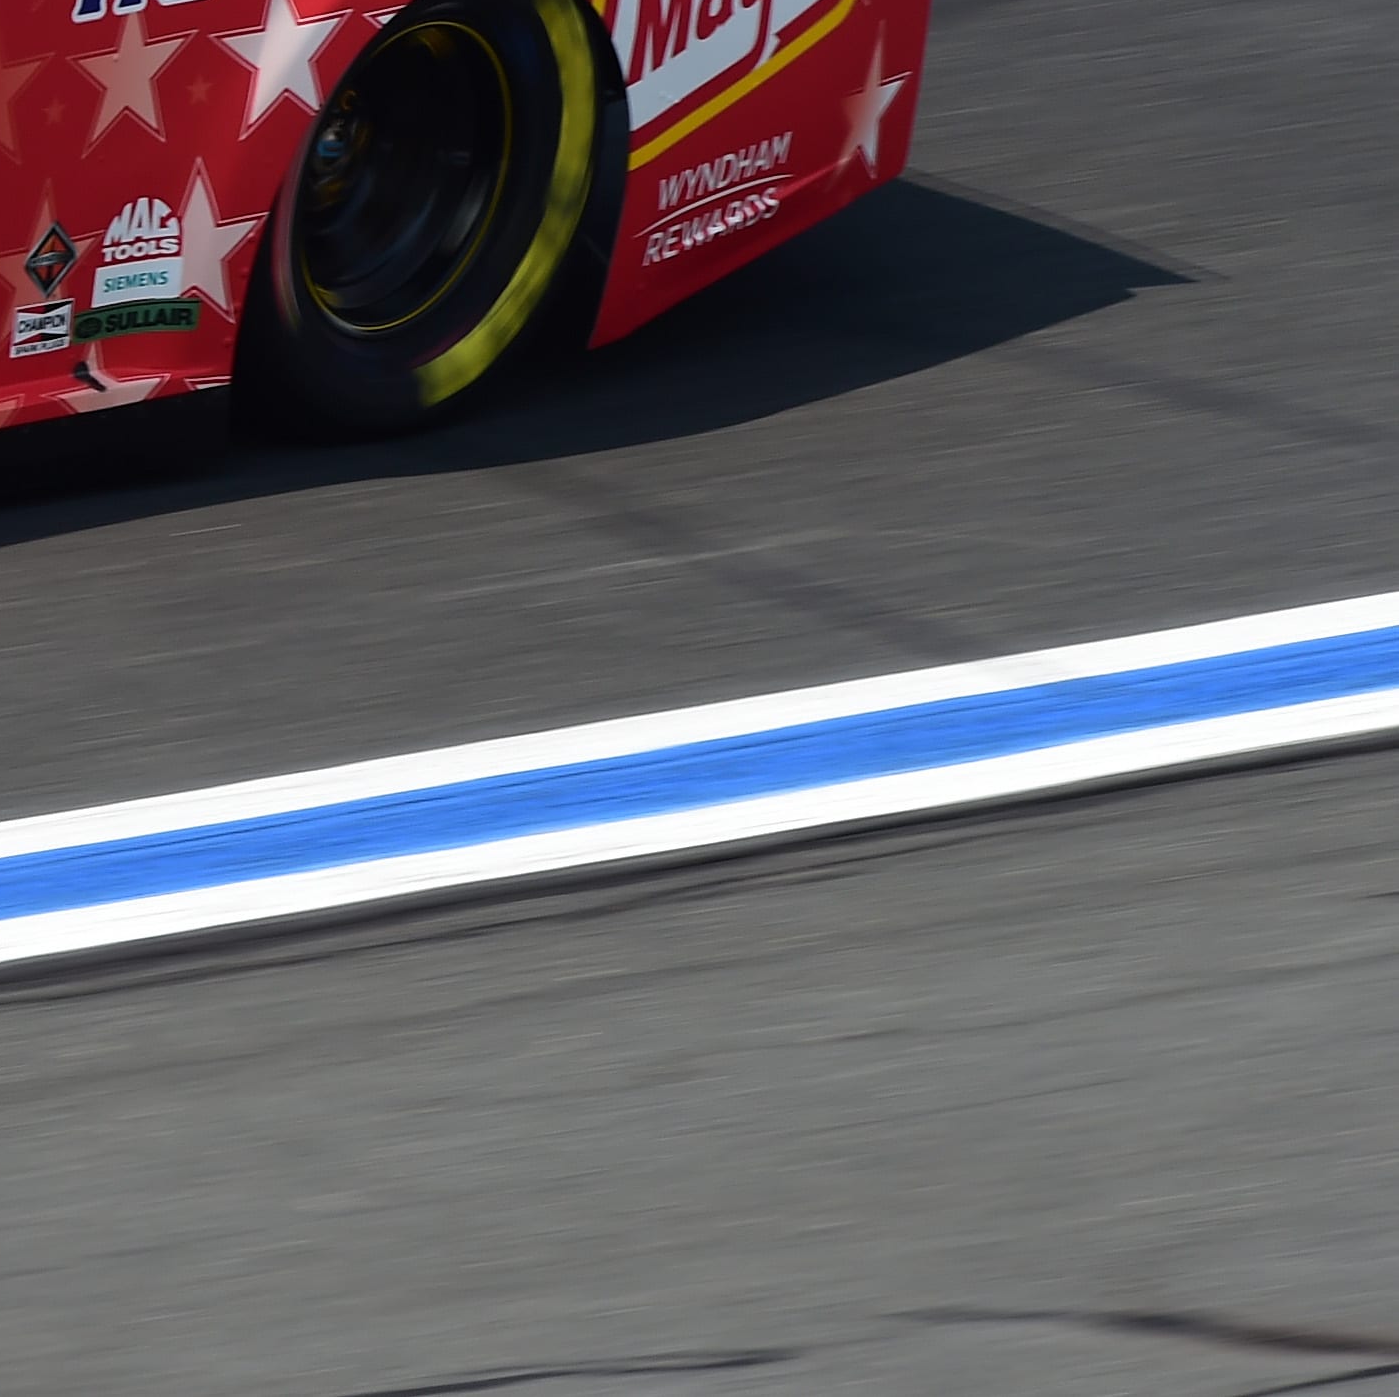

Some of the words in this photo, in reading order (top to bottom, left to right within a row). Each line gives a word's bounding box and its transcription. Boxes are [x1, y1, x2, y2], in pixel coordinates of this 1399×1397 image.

[657, 131, 792, 213] WYNDHAM
[103, 197, 180, 246] MAC
[642, 186, 780, 267] REWARDS
[102, 238, 180, 262] TOOLS
[104, 269, 169, 293] SIEMENS
[17, 314, 66, 334] CHAMPION
[105, 306, 194, 333] SULLAIR
